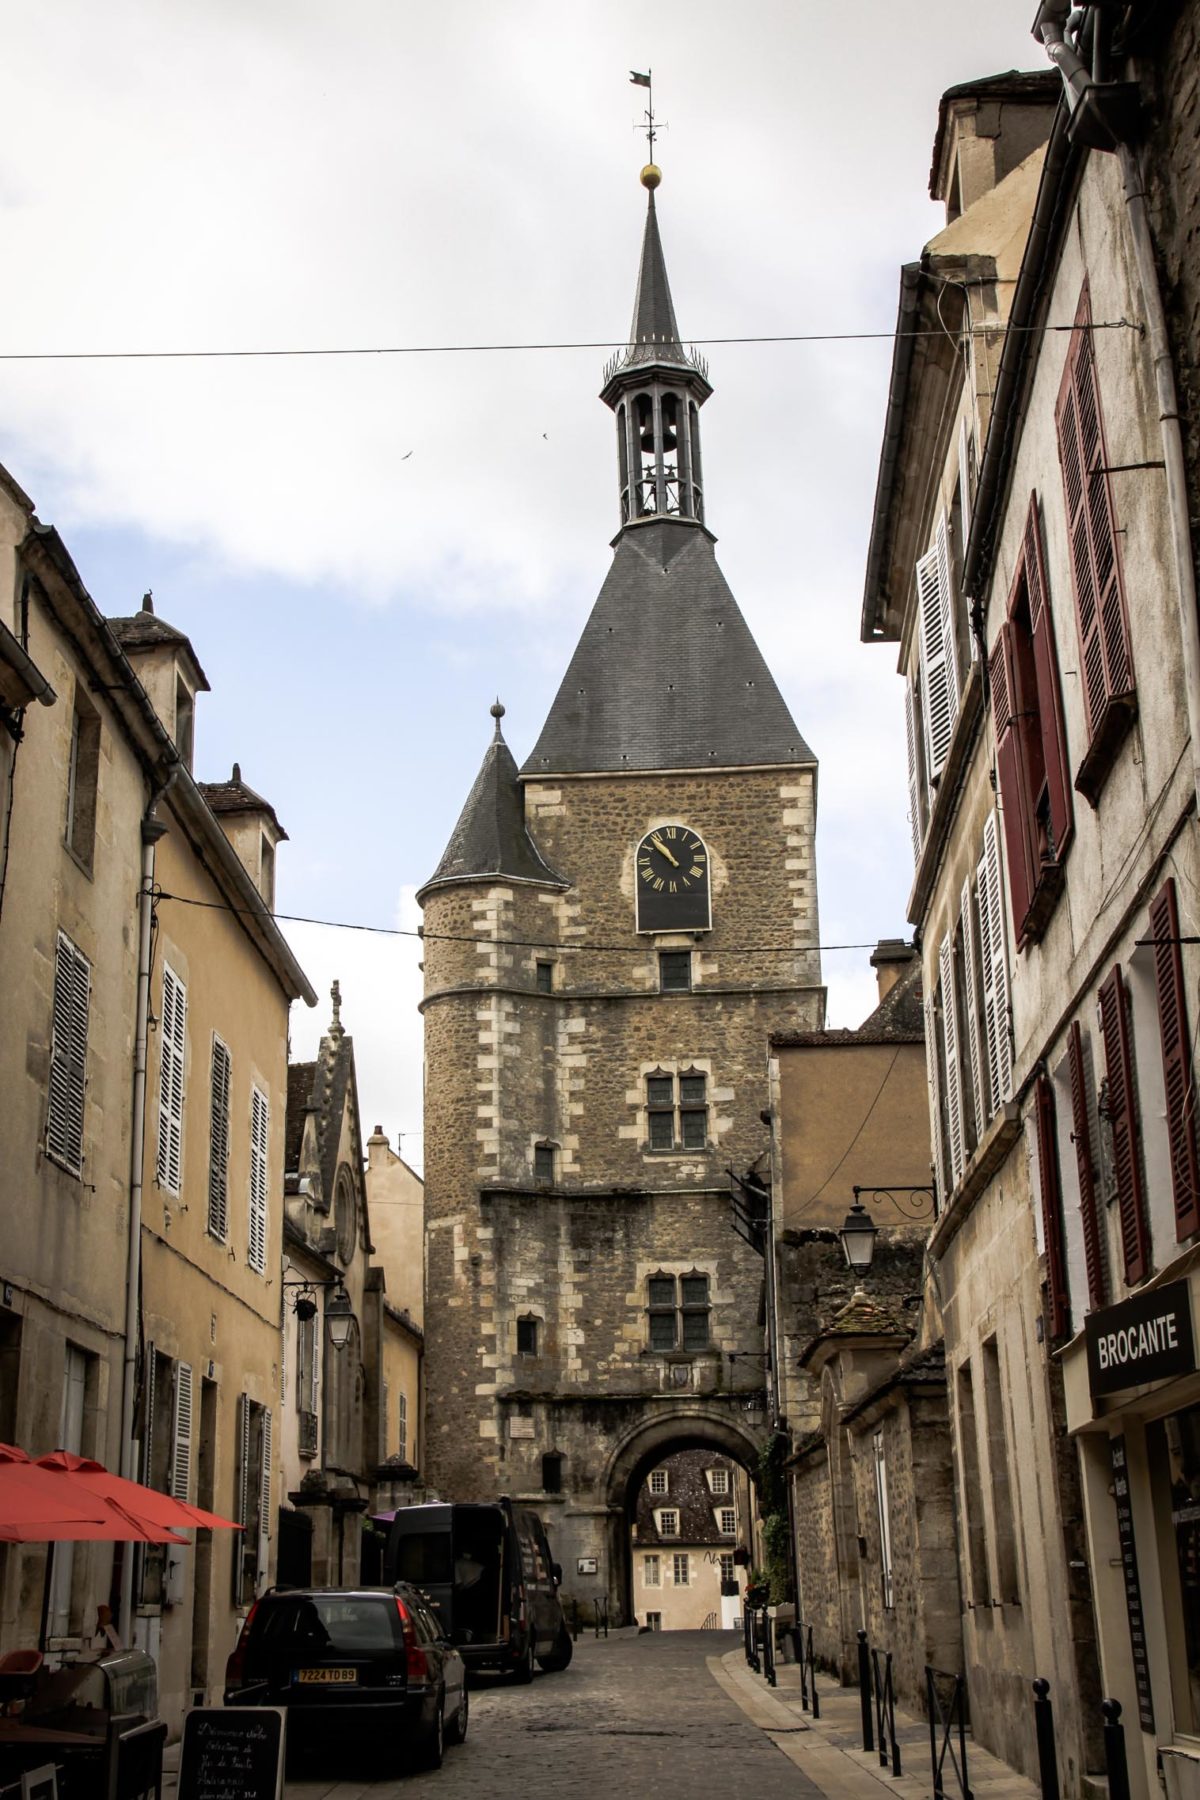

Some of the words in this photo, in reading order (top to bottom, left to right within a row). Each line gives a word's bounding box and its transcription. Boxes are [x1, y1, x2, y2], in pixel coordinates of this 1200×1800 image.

[666, 827, 677, 839] XII
[1098, 1313, 1178, 1369] BROCANTE
[302, 1669, 326, 1681] 7224
[329, 1669, 341, 1680] TD
